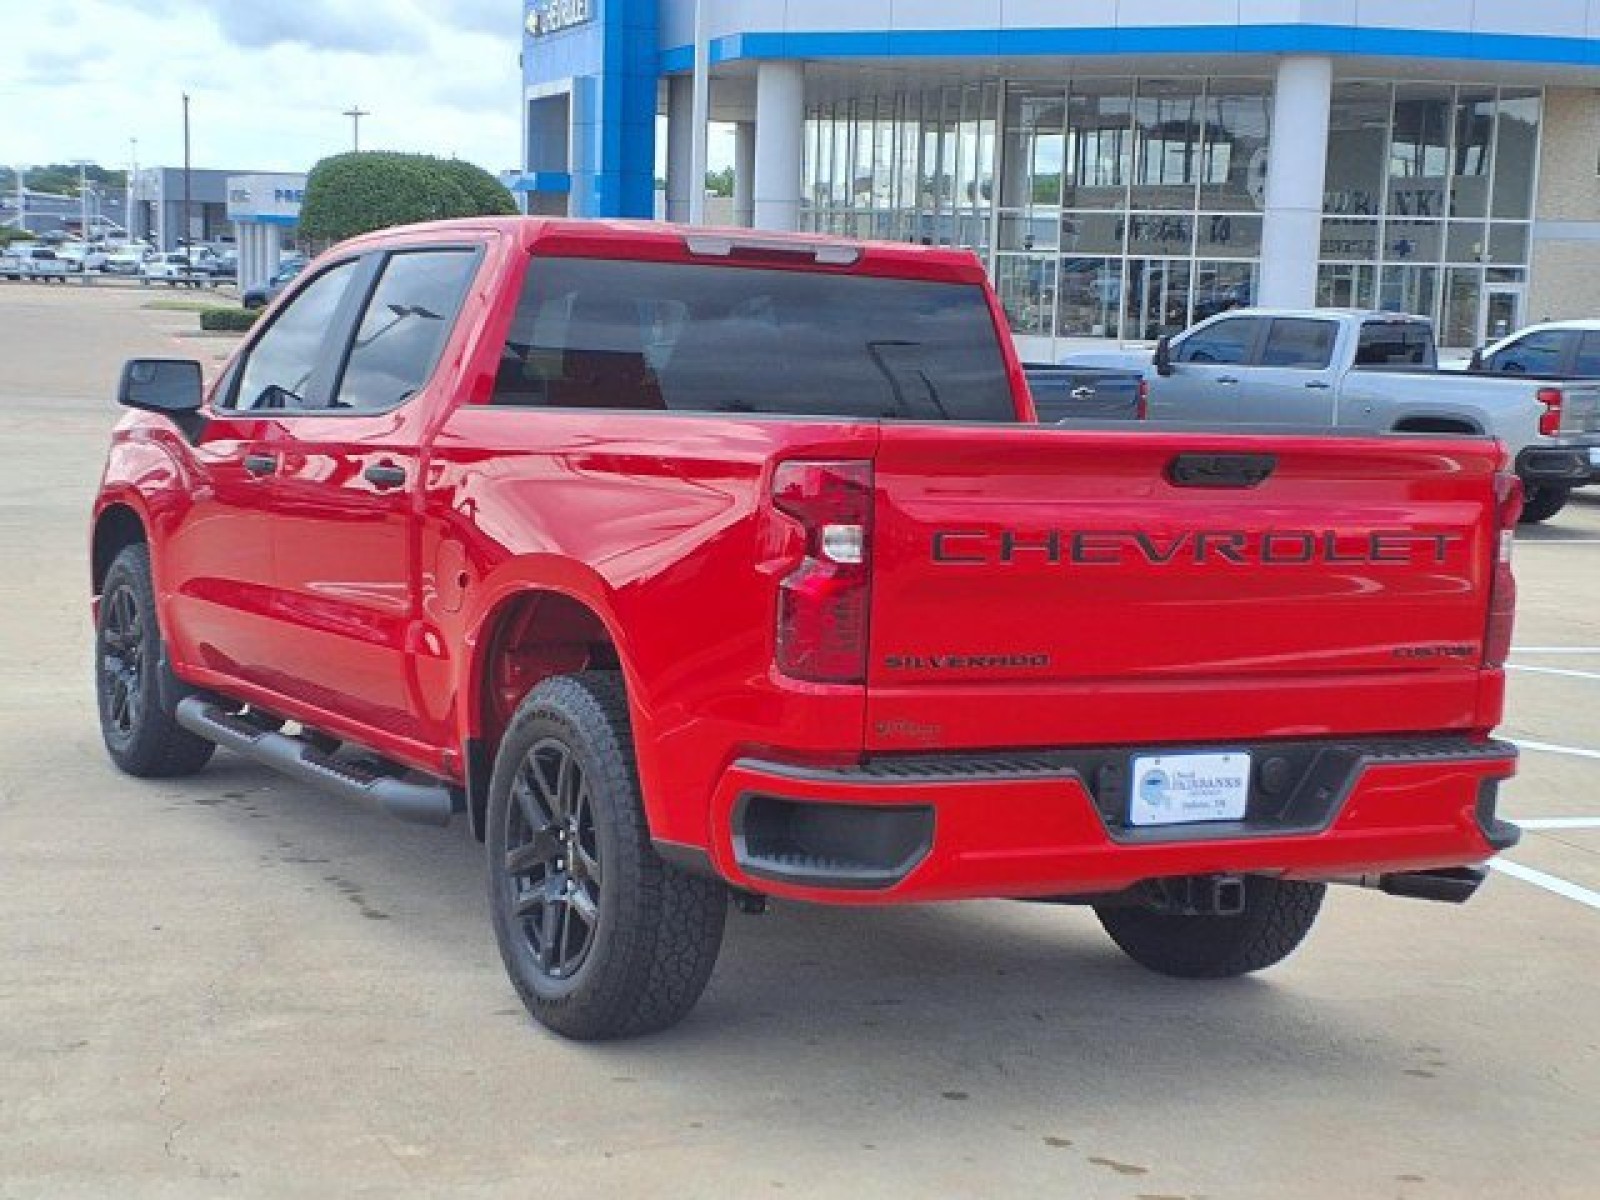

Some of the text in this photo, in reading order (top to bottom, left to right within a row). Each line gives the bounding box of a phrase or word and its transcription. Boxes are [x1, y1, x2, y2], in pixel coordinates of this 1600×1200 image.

[930, 529, 1463, 566] CHEVROLET
[1392, 643, 1476, 658] CUSTOM
[884, 654, 1051, 670] SILVERADO
